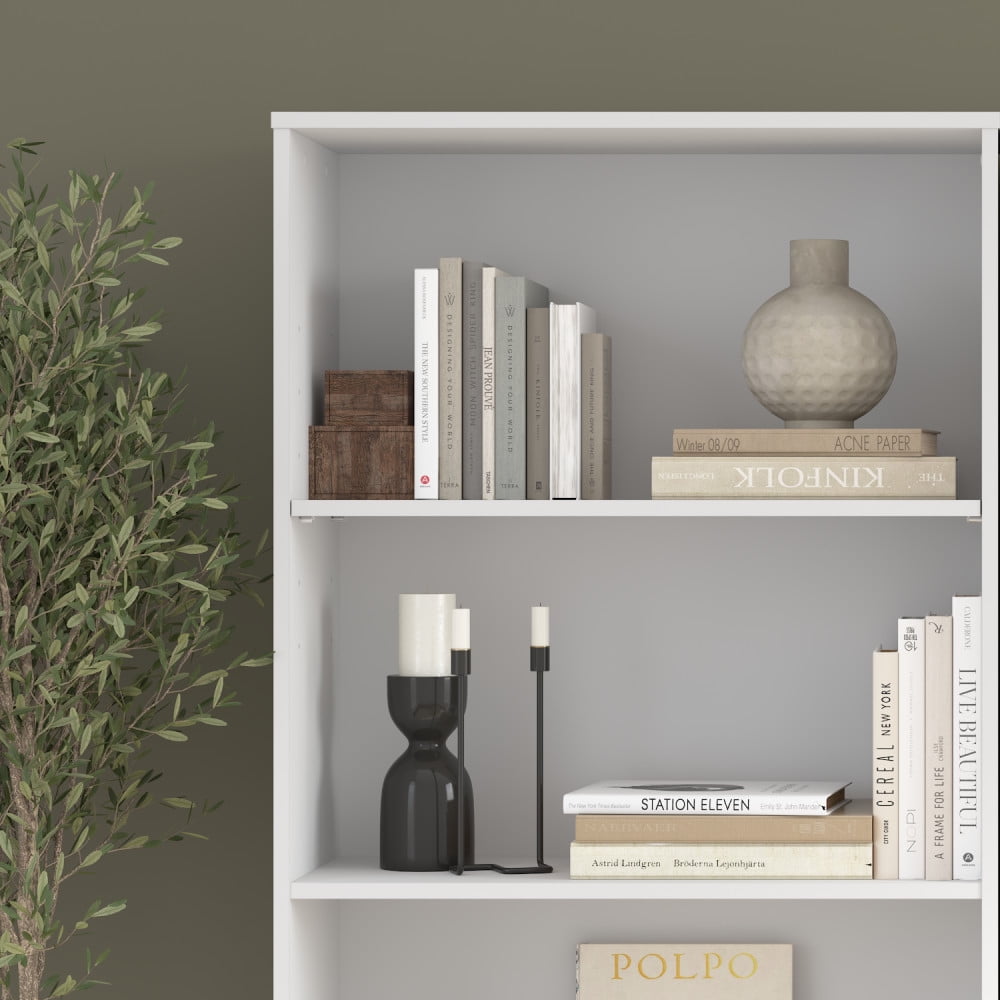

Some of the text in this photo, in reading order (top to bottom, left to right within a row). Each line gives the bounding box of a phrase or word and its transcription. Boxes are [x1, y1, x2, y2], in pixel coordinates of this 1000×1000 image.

[468, 282, 476, 306] KING
[468, 313, 476, 350] SPIDER
[468, 356, 476, 389] WITCH
[484, 347, 496, 410] JEAN PROUVÉ
[421, 342, 429, 443] THE NEW SOUTHERN STYLE
[468, 396, 476, 426] MOON
[676, 438, 740, 453] Winter 08/09
[834, 436, 911, 451] ACNE PAPER
[733, 467, 944, 488] THE KINFOLK
[881, 683, 891, 736] NEW YORK
[959, 669, 976, 834] LIVE BEAUTIFUL
[876, 744, 895, 807] CEREAL
[934, 767, 944, 787] LIFE
[641, 798, 696, 811] STATION
[701, 799, 750, 811] ELEVEN
[934, 790, 944, 810] FOR
[934, 812, 944, 846] FRAME
[591, 858, 619, 867] Astrid
[621, 858, 661, 870] Lindgren
[673, 858, 714, 867] Bröderna
[610, 952, 758, 980] POLPO
